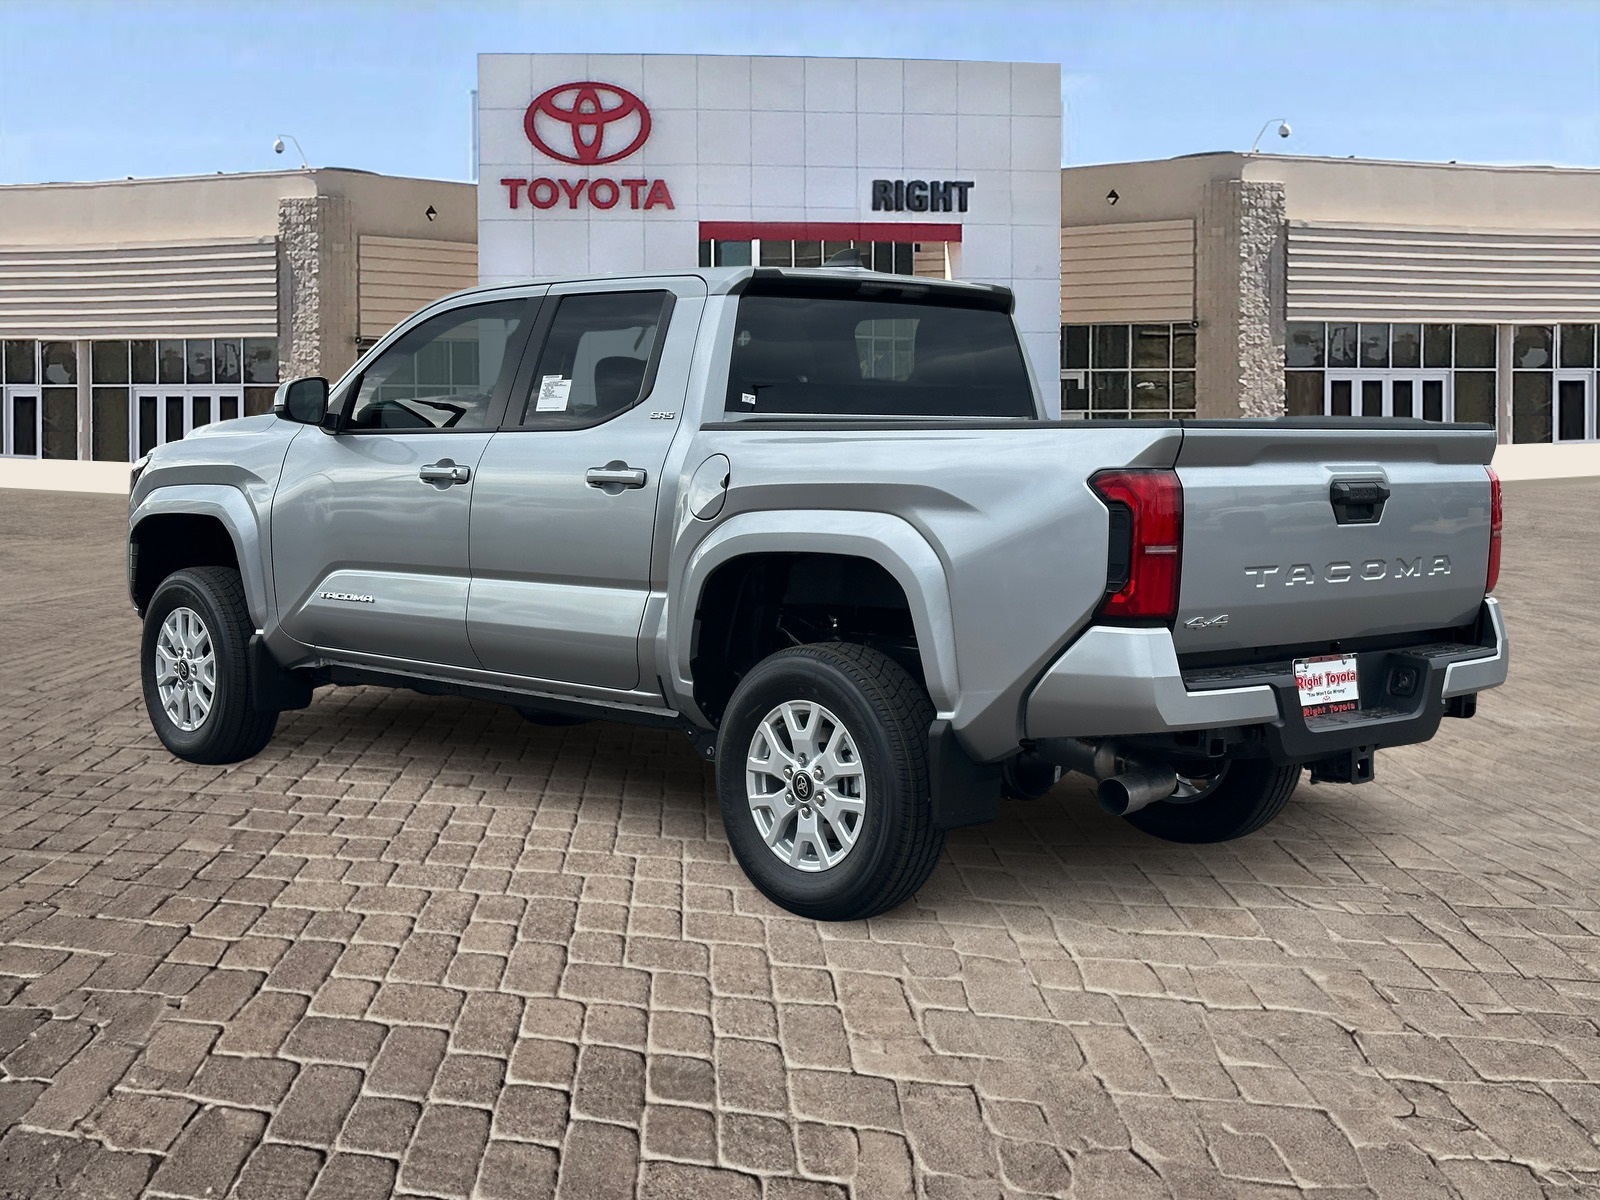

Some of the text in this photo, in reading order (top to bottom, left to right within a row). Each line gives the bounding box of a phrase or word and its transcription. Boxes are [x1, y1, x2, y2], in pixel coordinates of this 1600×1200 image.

[500, 178, 675, 210] TOYOTA
[870, 179, 975, 213] RIGHT
[1244, 554, 1452, 588] TACOMA
[319, 591, 375, 603] TACOMA
[1296, 669, 1356, 691] Right Toyota
[1303, 702, 1355, 717] Right Toyota
